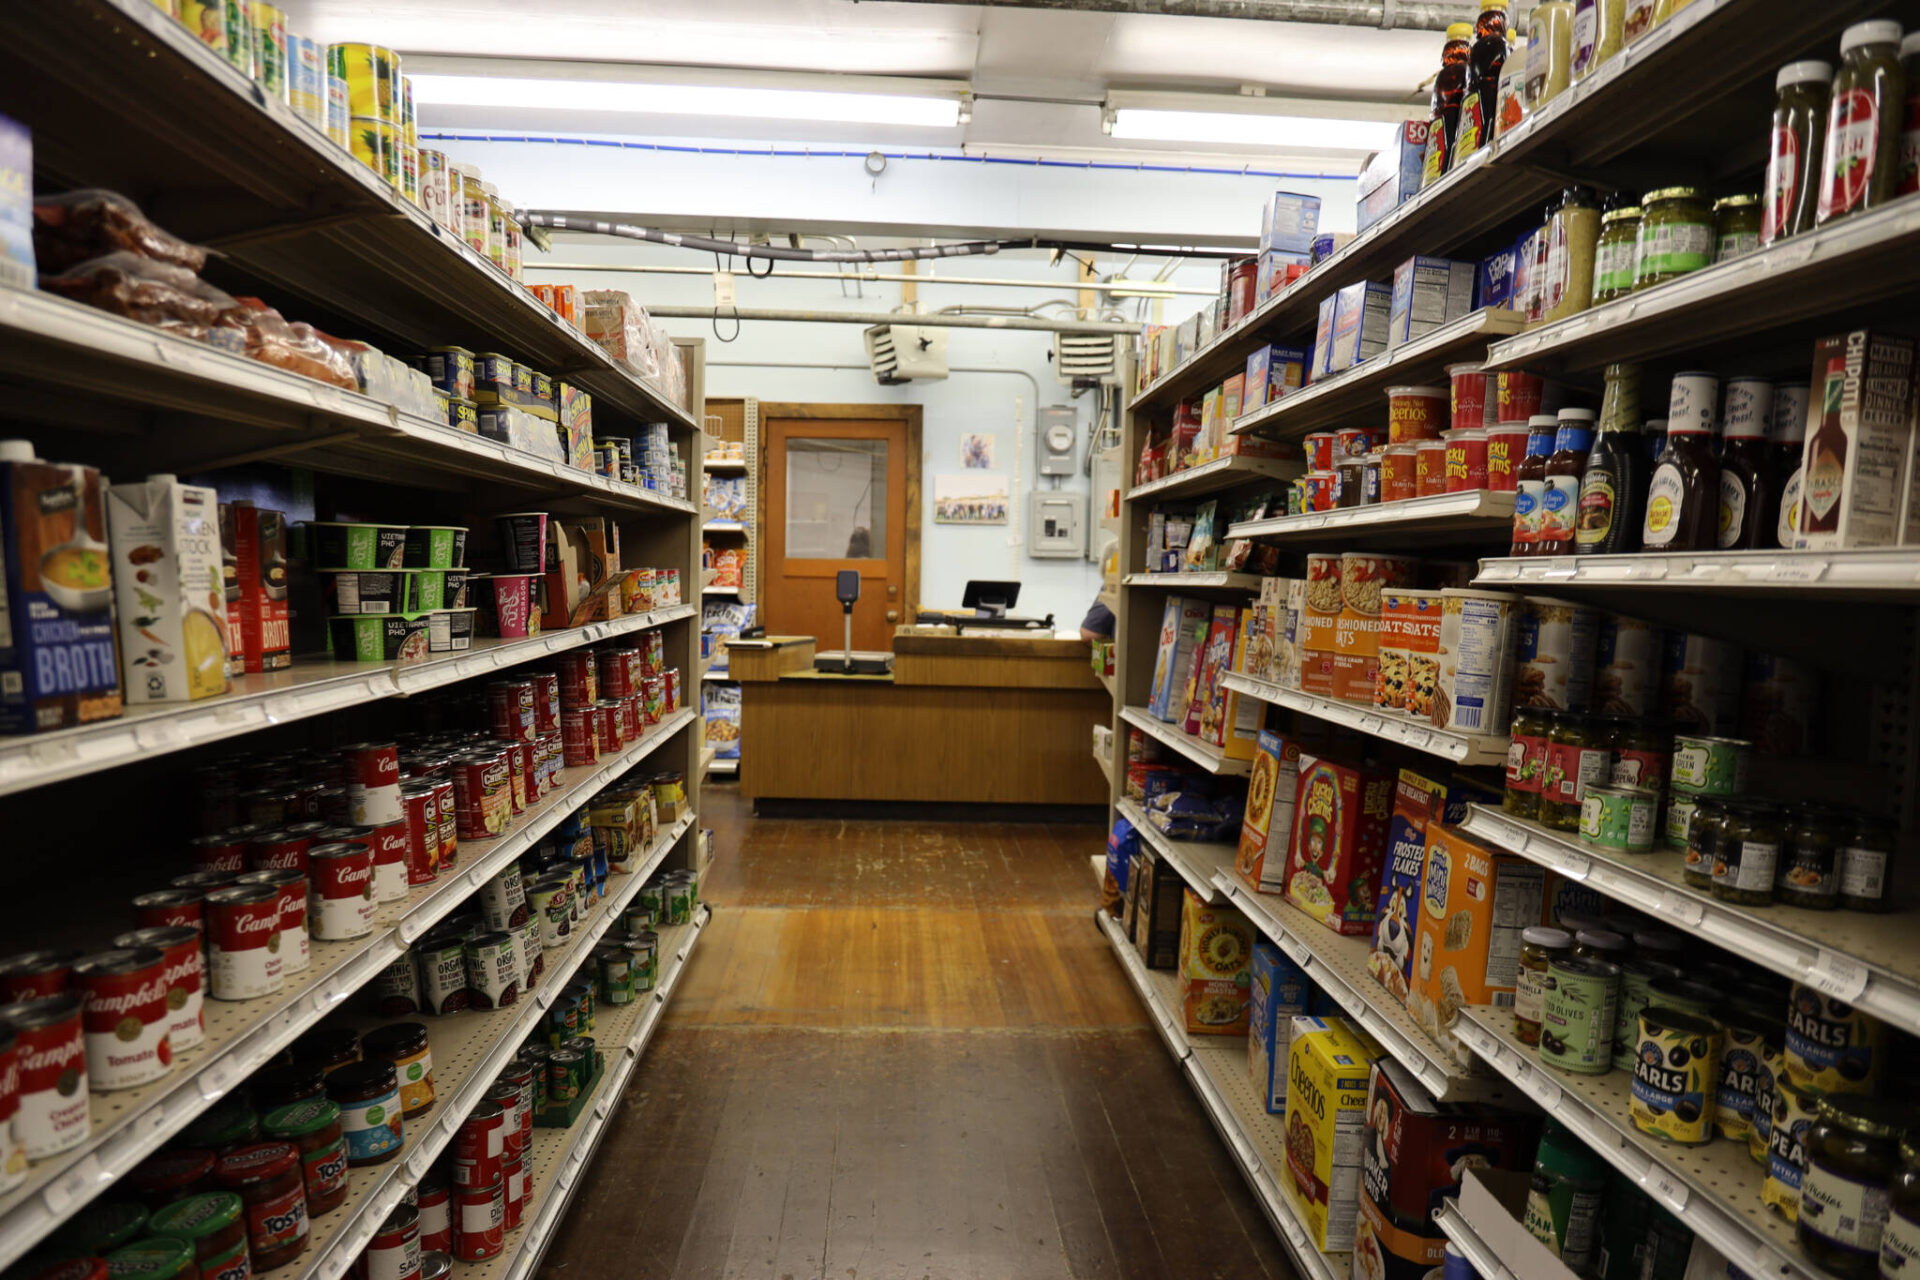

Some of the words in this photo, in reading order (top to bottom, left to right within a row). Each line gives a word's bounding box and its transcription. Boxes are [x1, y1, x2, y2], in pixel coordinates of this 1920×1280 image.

[1408, 124, 1428, 139] 50
[381, 540, 395, 548] PHO
[262, 620, 290, 649] BROTH
[35, 641, 117, 694] BROTH
[1393, 841, 1425, 861] FROSTED
[1392, 856, 1420, 876] FLAKES
[1430, 863, 1447, 884] Mini
[1464, 853, 1470, 869] 2
[1470, 856, 1489, 877] BAGS
[1556, 1007, 1584, 1021] OLIVES
[106, 1050, 155, 1067] Tomato
[1803, 1043, 1835, 1061] LARGE
[1290, 1052, 1325, 1121] Cheerios
[1646, 1090, 1673, 1105] LARGE
[1771, 1130, 1803, 1165] PEA
[1772, 1161, 1798, 1179] EXTRA
[1364, 1169, 1380, 1202] OATS
